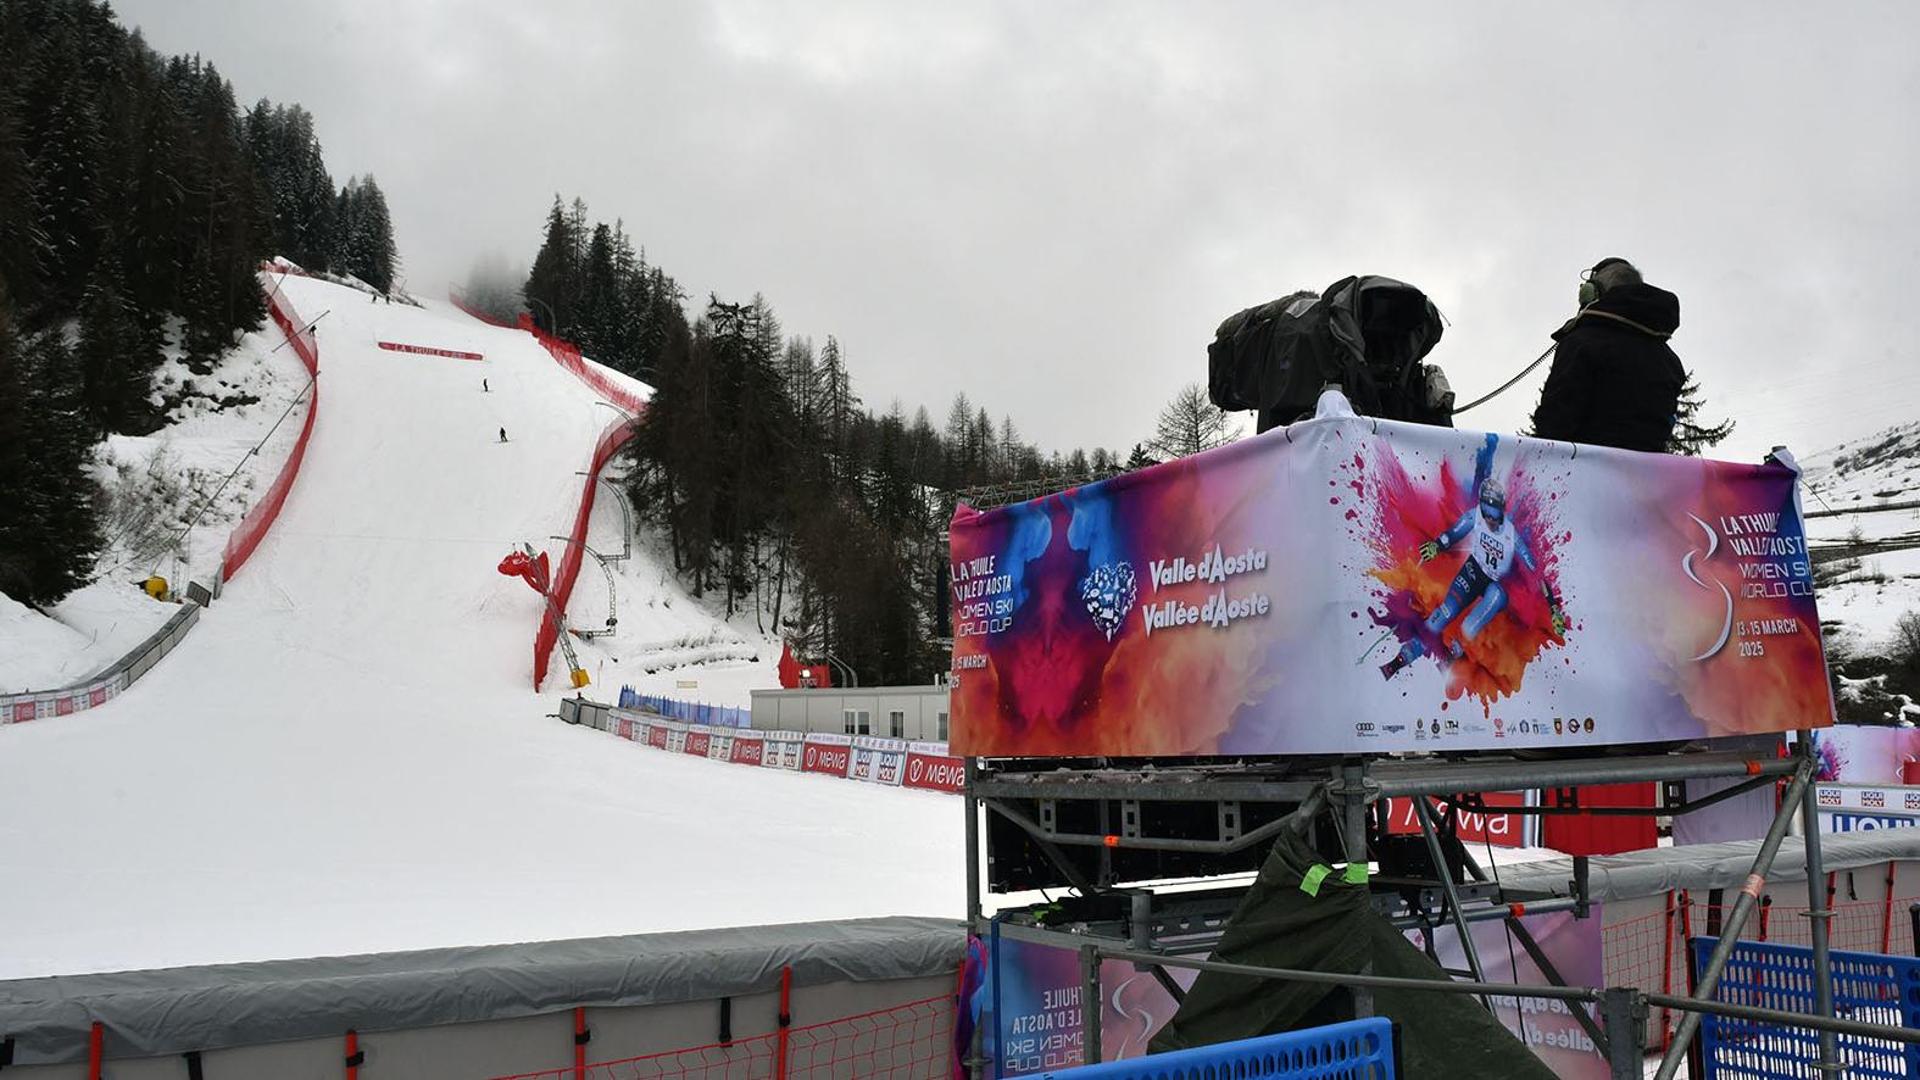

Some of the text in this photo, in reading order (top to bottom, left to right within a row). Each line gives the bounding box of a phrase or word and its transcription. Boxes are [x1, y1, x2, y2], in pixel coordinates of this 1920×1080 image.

[1720, 516, 1742, 535] LA
[1149, 543, 1267, 593] Valle d'Aosta
[1485, 552, 1498, 570] 14
[950, 562, 969, 582] LA
[1791, 580, 1813, 597] CU
[995, 598, 1014, 615] SKI
[1142, 586, 1269, 638] Vallée d'Aoste
[956, 616, 1012, 637] ORLD CUP
[1761, 618, 1798, 635] MARCH
[1738, 641, 1764, 657] 2025
